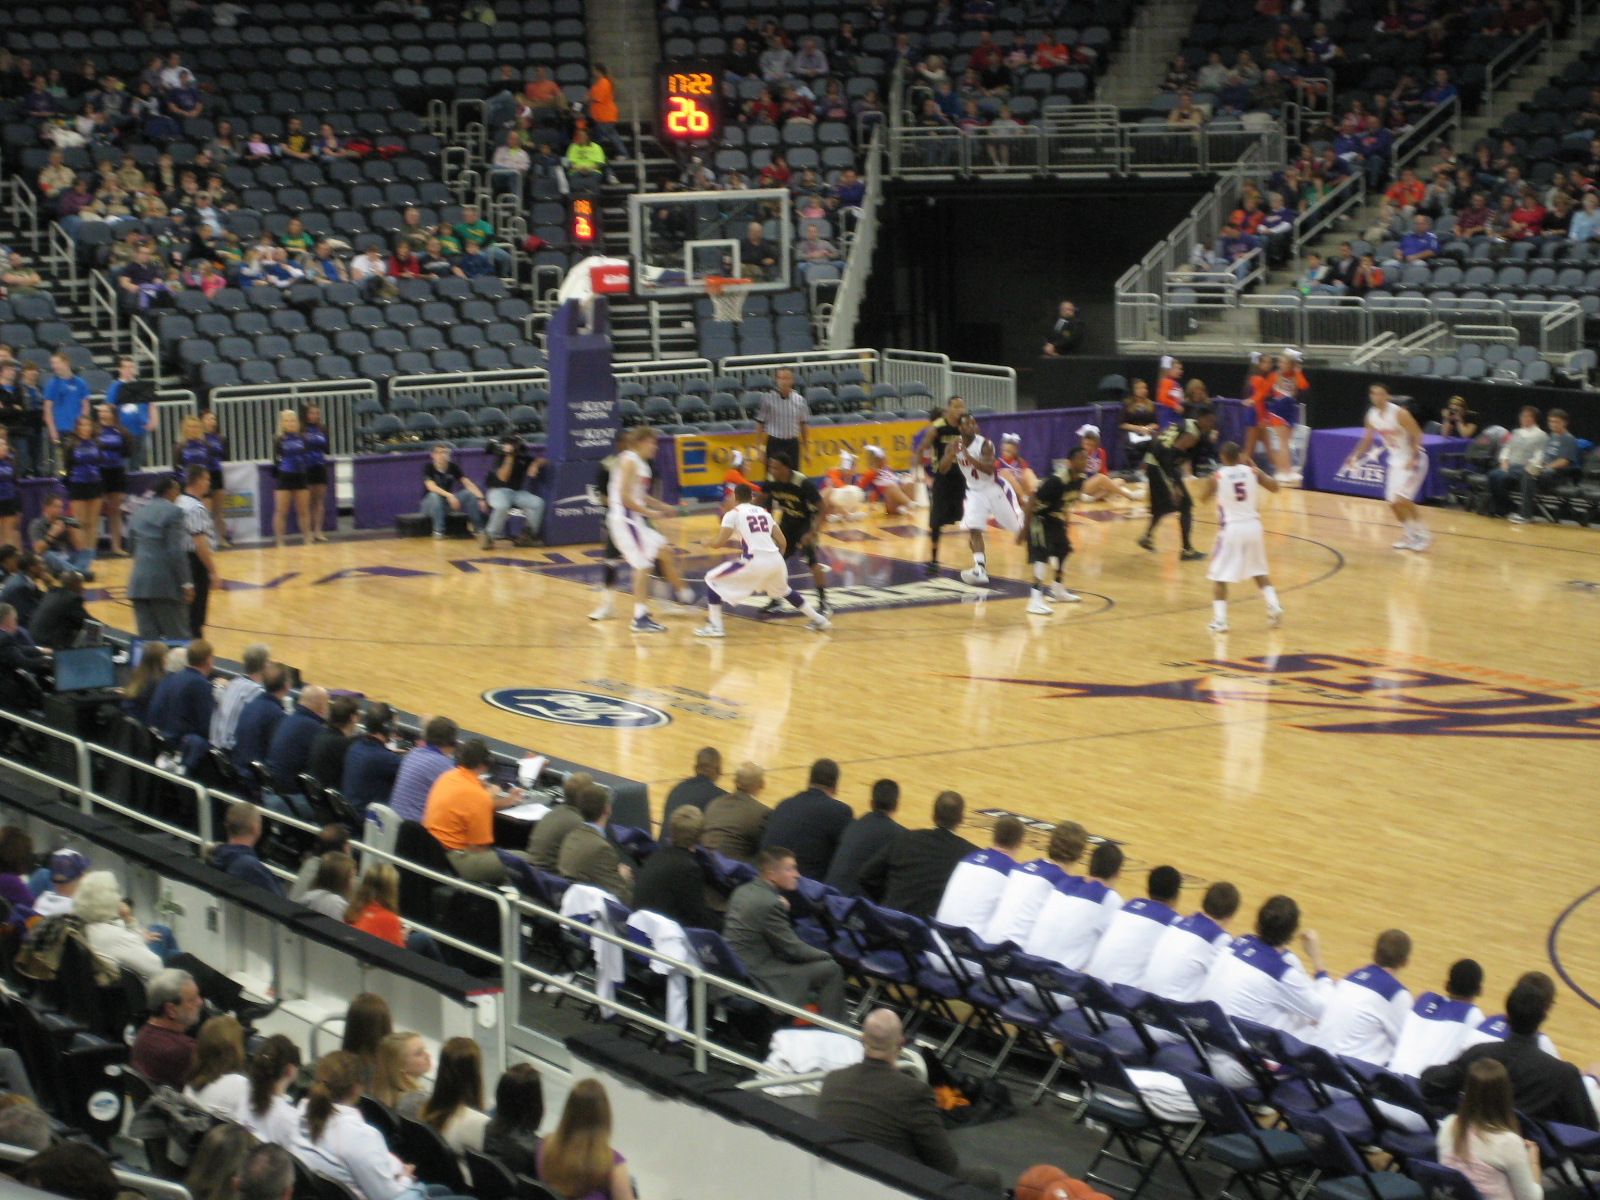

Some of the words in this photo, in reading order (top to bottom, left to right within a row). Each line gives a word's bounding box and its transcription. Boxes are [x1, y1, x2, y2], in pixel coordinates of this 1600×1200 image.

[712, 445, 760, 464] OD
[1232, 481, 1248, 502] 5
[746, 515, 770, 533] 22
